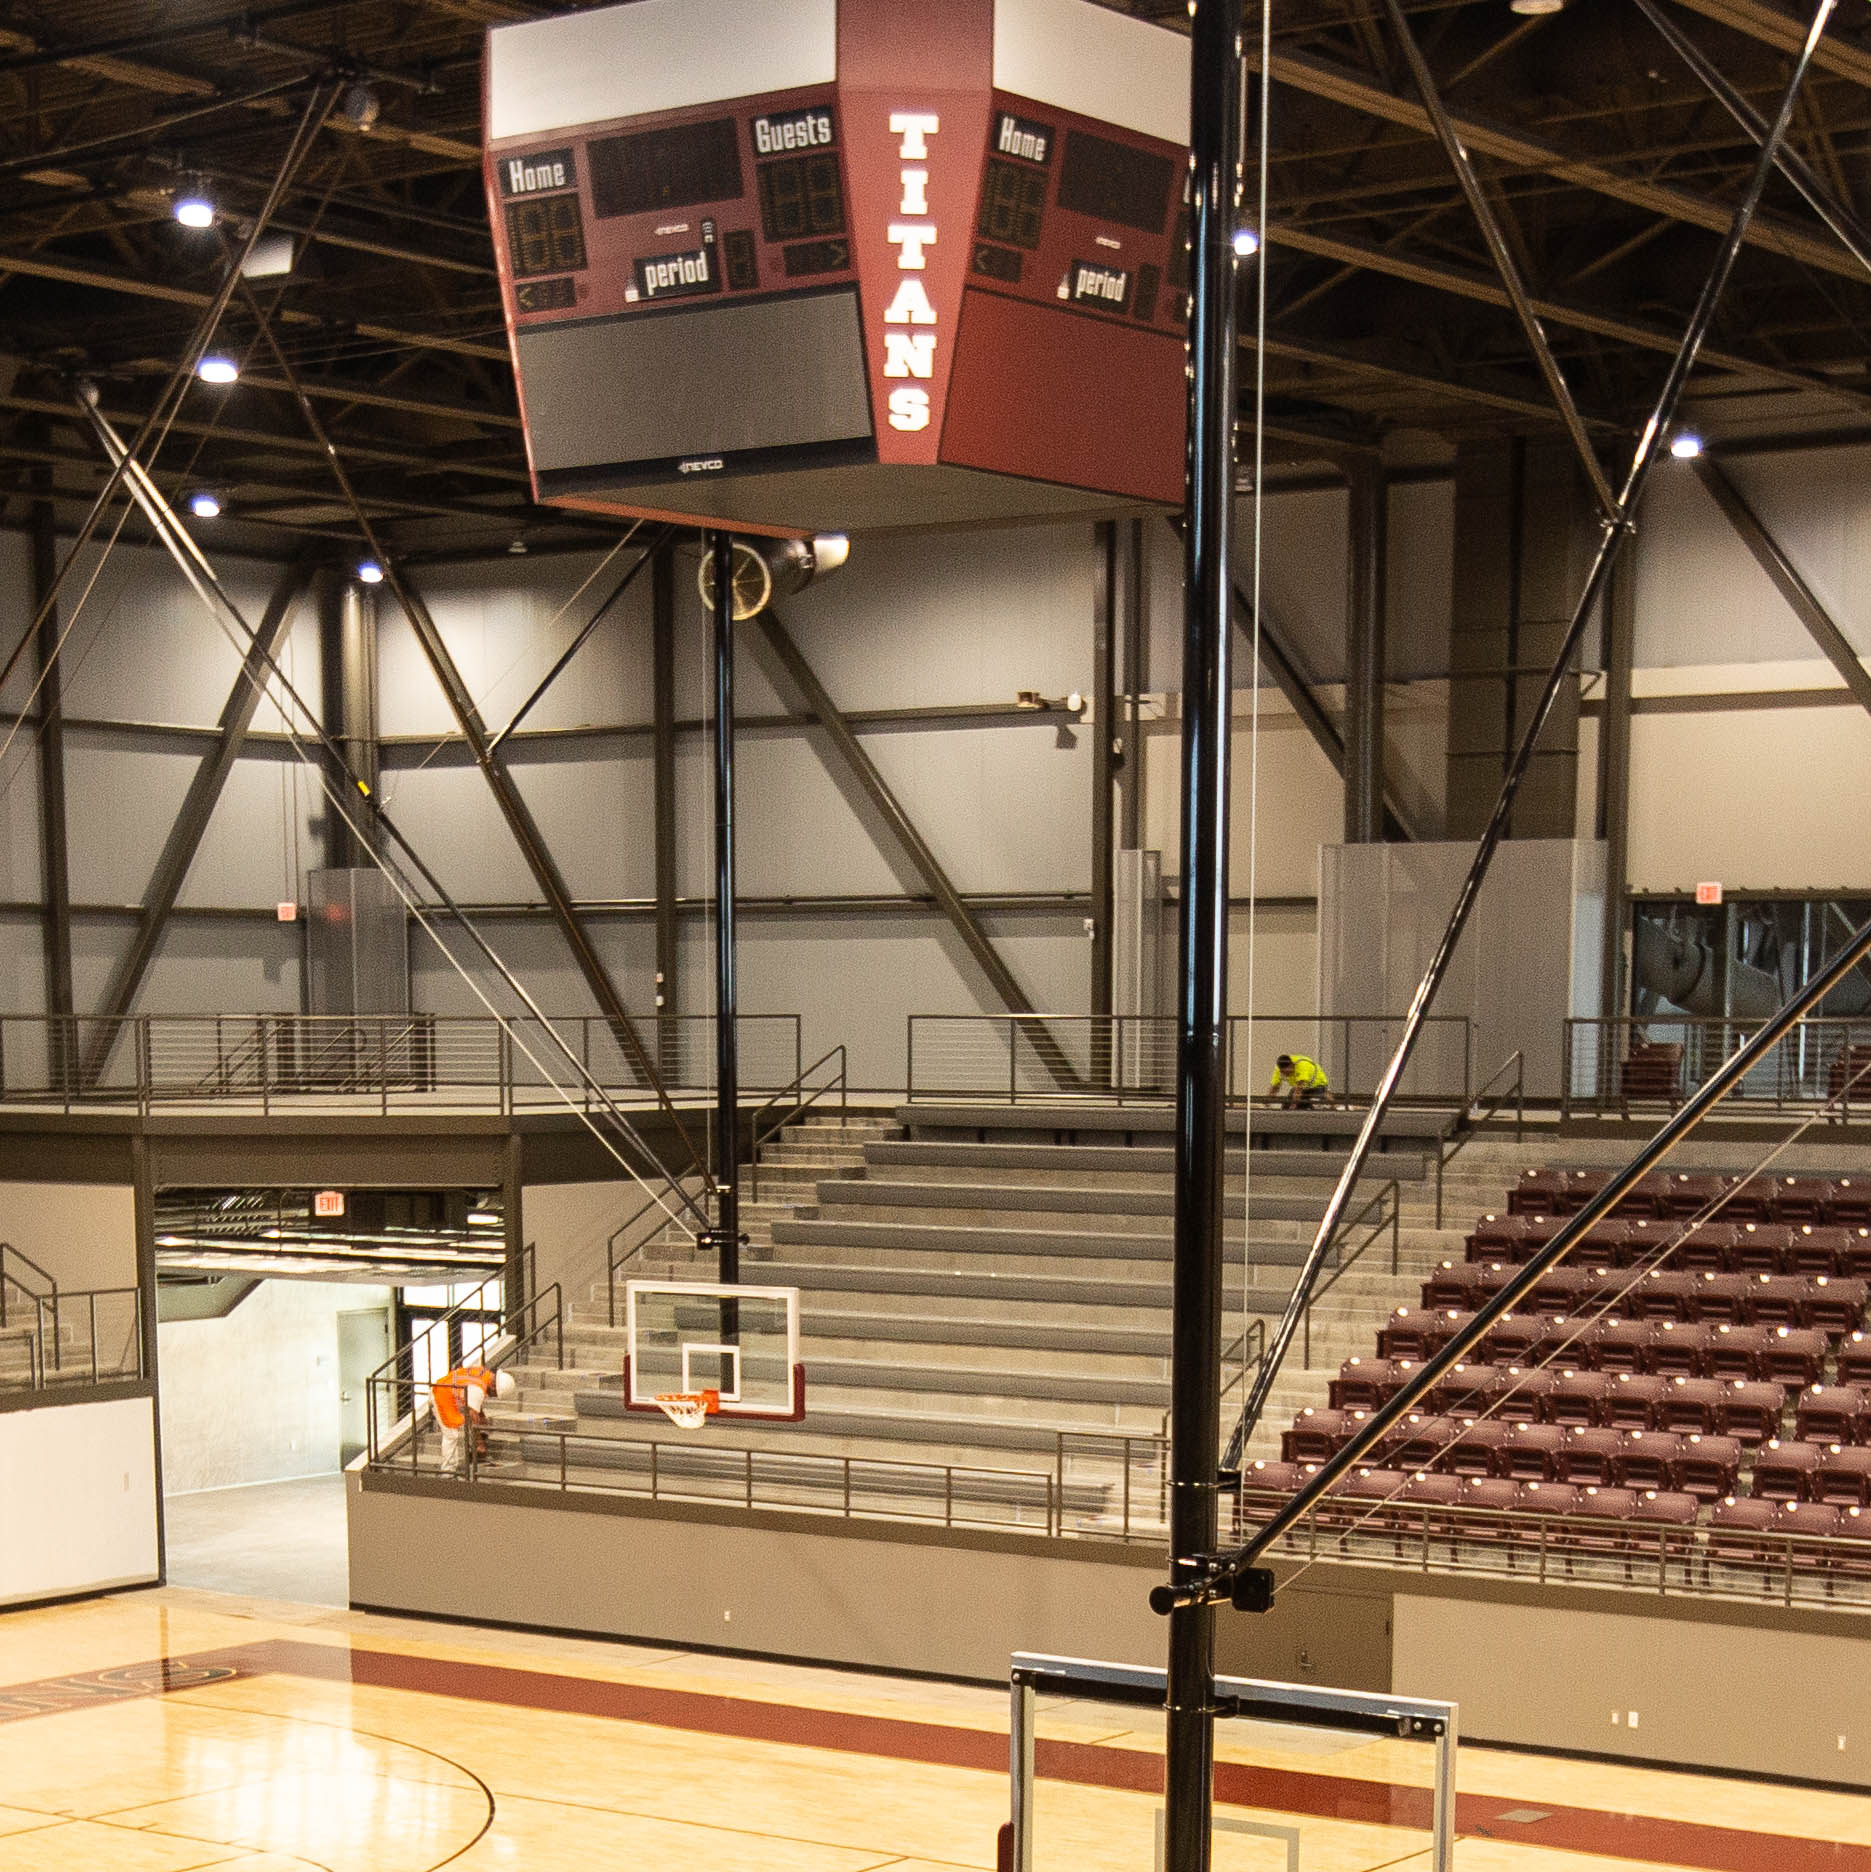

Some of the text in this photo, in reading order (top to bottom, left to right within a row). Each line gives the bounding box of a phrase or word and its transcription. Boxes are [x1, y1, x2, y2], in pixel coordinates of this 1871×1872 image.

[754, 113, 832, 153] Guests
[999, 115, 1046, 161] Home
[508, 159, 567, 194] Home
[644, 250, 709, 297] period
[882, 113, 940, 432] TITANS
[1074, 269, 1127, 302] period
